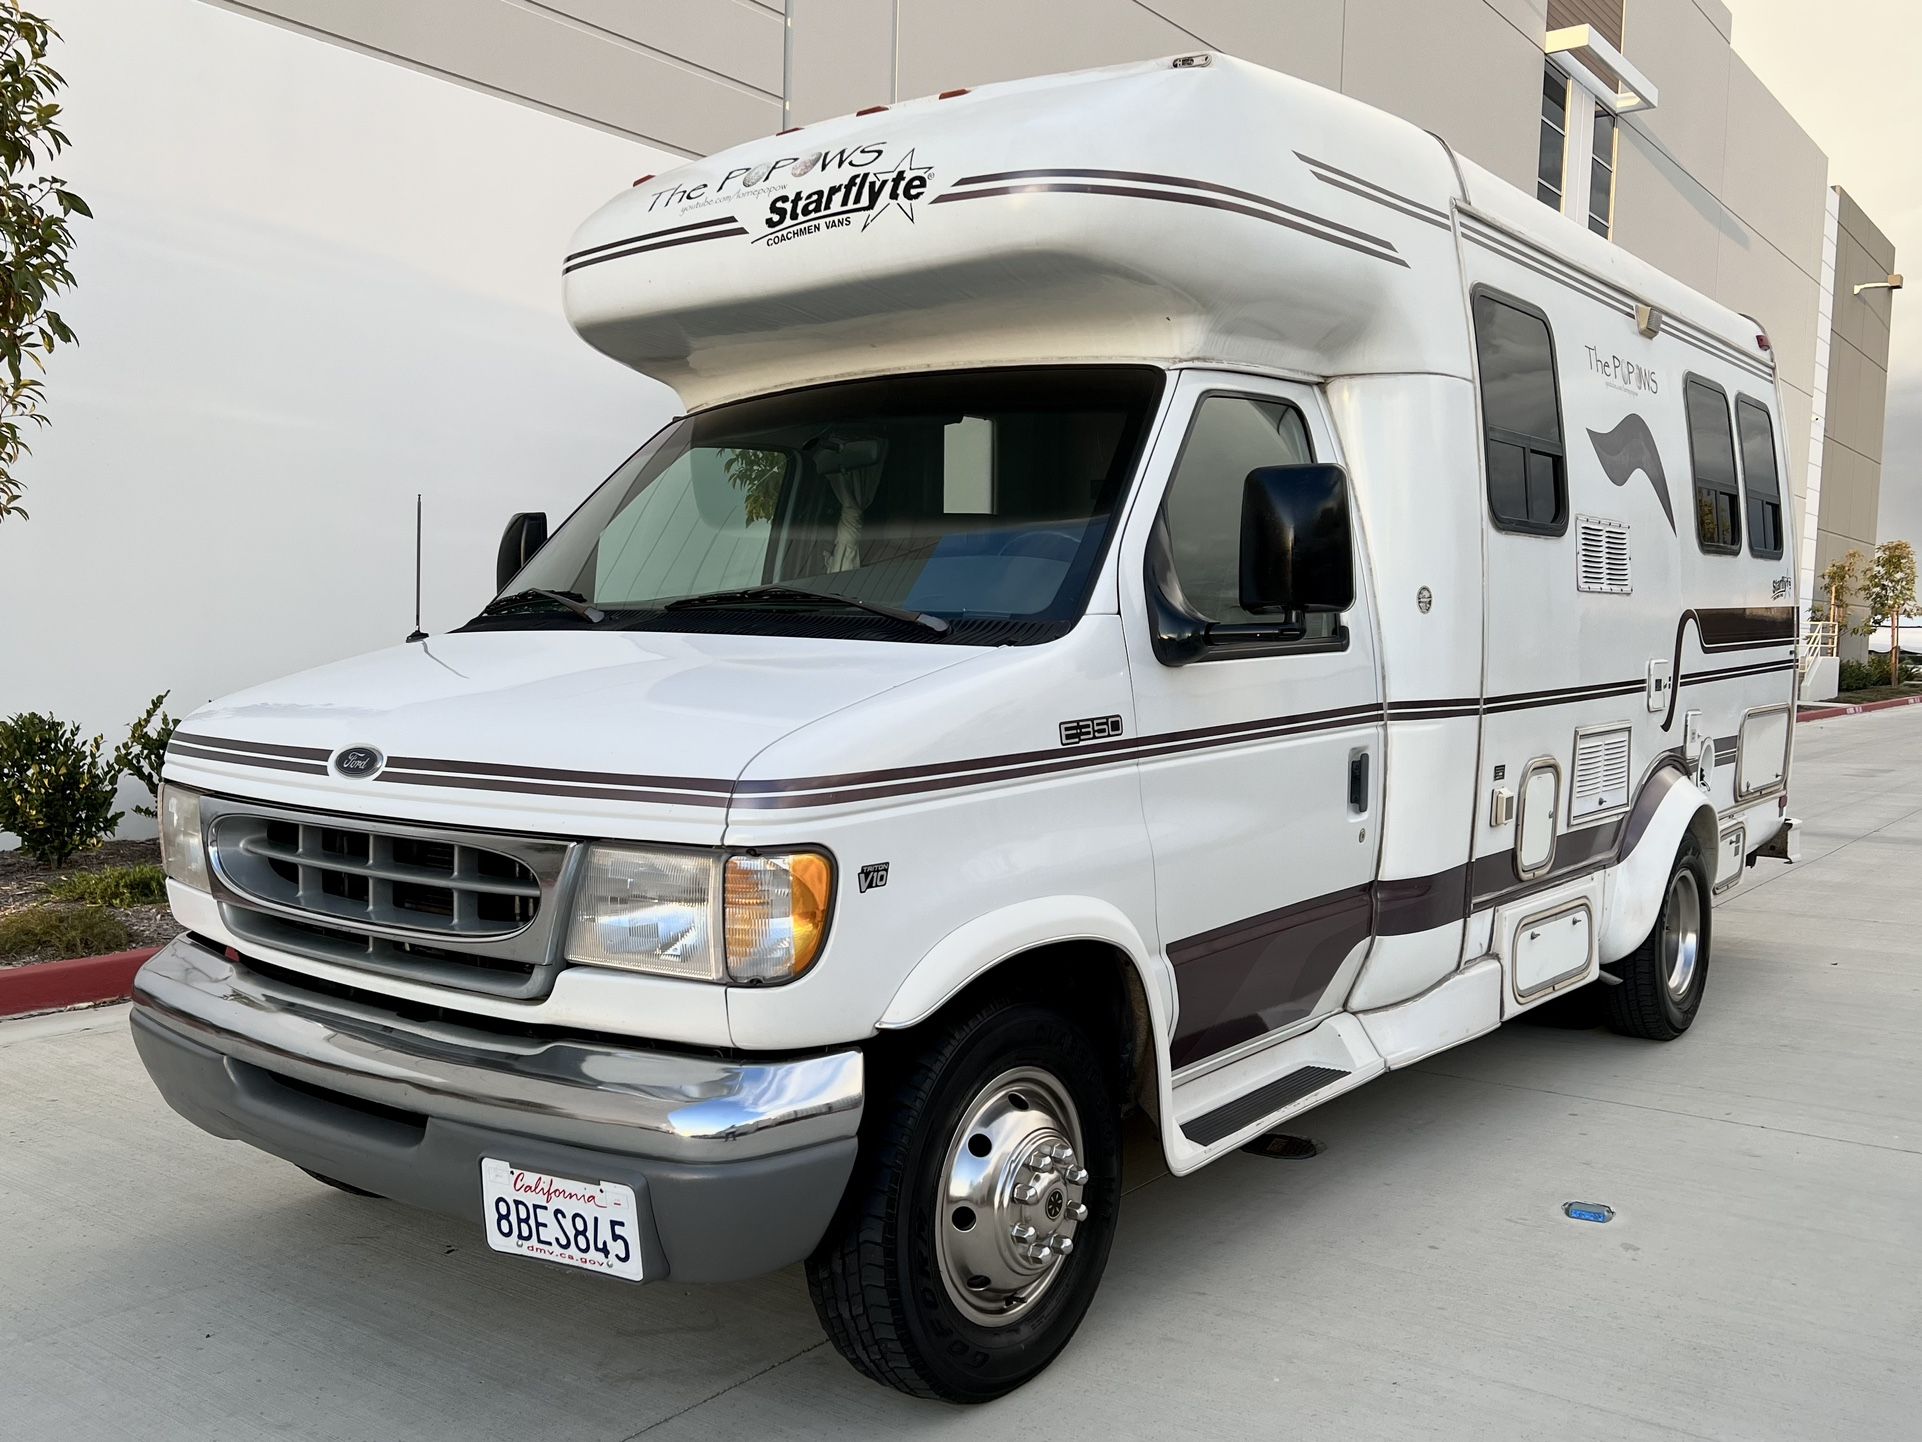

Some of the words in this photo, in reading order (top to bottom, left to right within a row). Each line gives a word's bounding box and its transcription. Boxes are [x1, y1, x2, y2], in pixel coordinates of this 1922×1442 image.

[648, 182, 708, 213] The
[765, 169, 929, 229] Starflyte
[766, 223, 821, 247] COACHMEN
[824, 216, 852, 230] VANS
[1584, 345, 1611, 377] The
[343, 751, 370, 769] Ford
[859, 870, 887, 892] V10
[862, 863, 889, 873] TRITON
[513, 1172, 607, 1208] California
[494, 1196, 631, 1264] 8BES845
[527, 1245, 605, 1267] dmv.ca.gov
